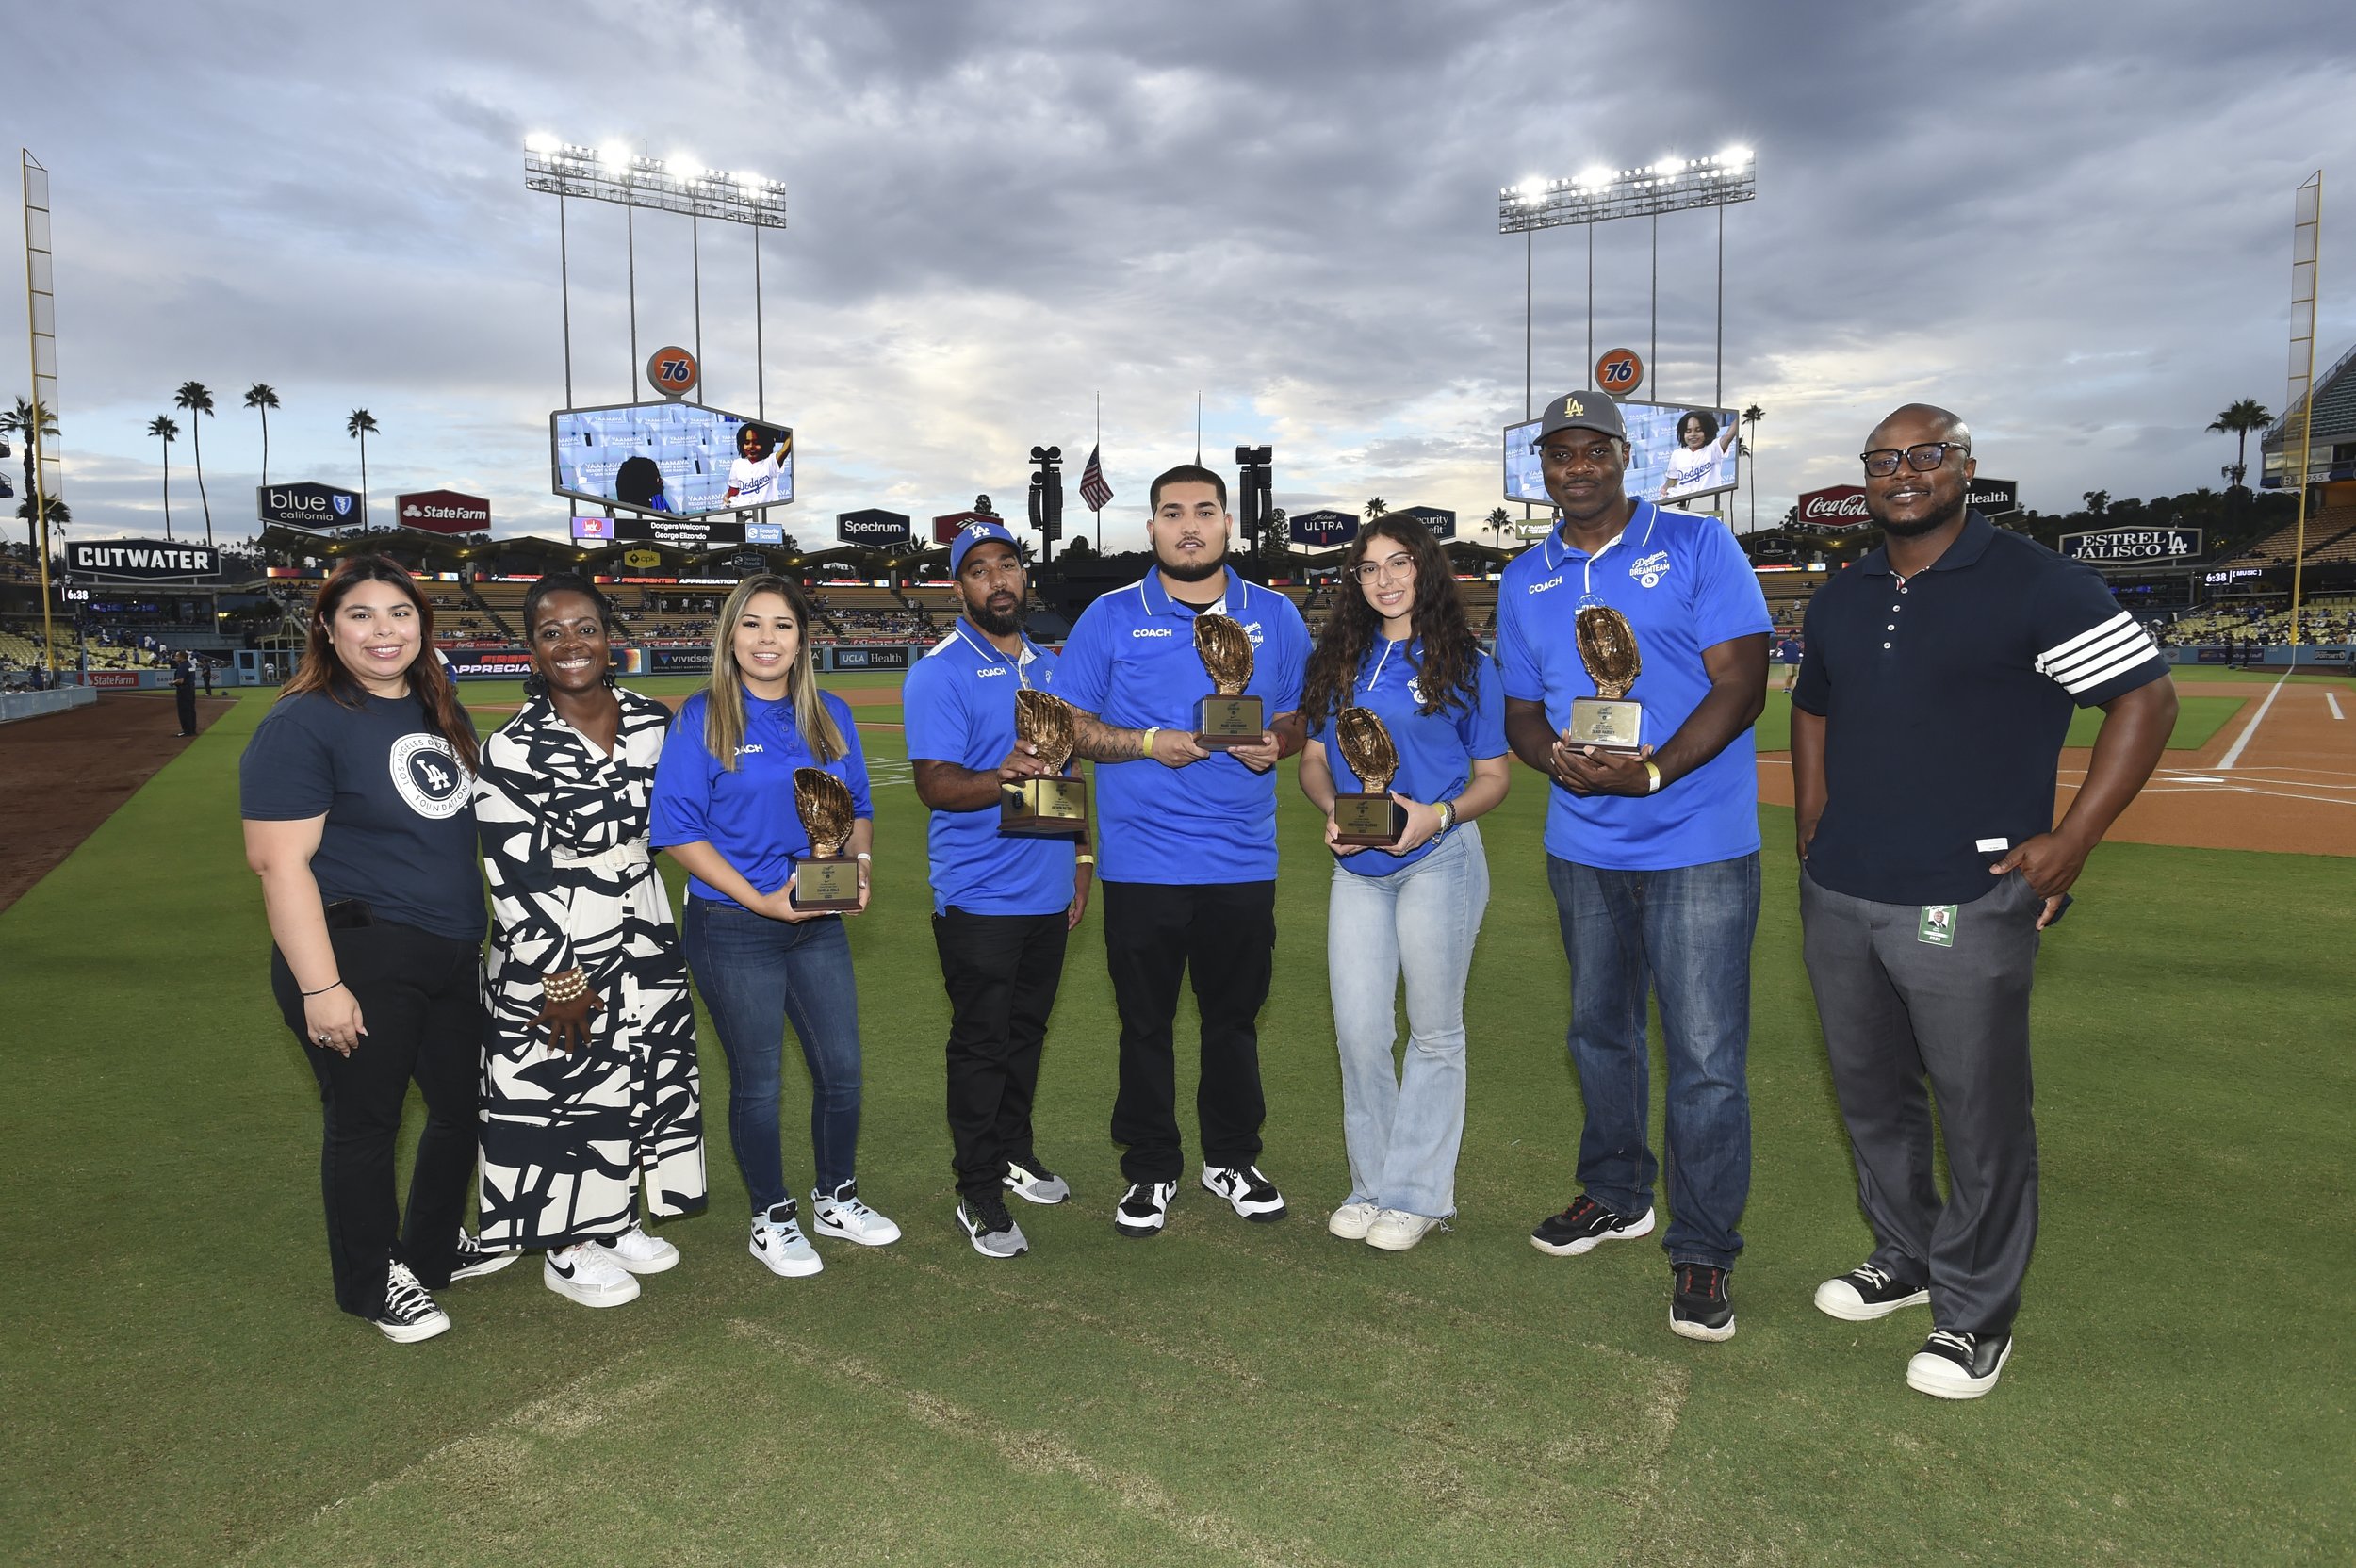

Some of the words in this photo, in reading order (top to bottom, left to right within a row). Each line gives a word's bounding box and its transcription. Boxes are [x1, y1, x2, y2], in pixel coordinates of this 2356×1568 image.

[661, 359, 690, 383] 76
[1604, 359, 1633, 383] 76
[1564, 398, 1584, 417] LA
[270, 489, 326, 511] blue
[1966, 492, 2008, 504] Health
[280, 510, 334, 521] california
[651, 522, 679, 531] Dodgers
[680, 523, 710, 531] Welcome
[760, 528, 780, 536] Security
[844, 520, 901, 534] Spectrum
[969, 525, 990, 539] LA
[1305, 521, 1344, 531] ULTRA
[655, 531, 679, 540] George
[2081, 532, 2166, 547] ESTREL
[2168, 531, 2187, 554] LA
[78, 547, 209, 570] CUTWATER
[2071, 545, 2161, 559] JALISCO
[640, 555, 656, 564] cpk
[2206, 573, 2227, 582] 6:38
[1529, 576, 1562, 595] COACH
[67, 587, 89, 600] 6:38
[1133, 629, 1172, 638] COACH
[871, 653, 902, 662] Health
[977, 667, 1006, 678] COACH
[398, 739, 424, 763] ANGELES
[399, 766, 410, 785] LOS
[416, 760, 451, 791] LA
[416, 785, 467, 811] FOUNDATION
